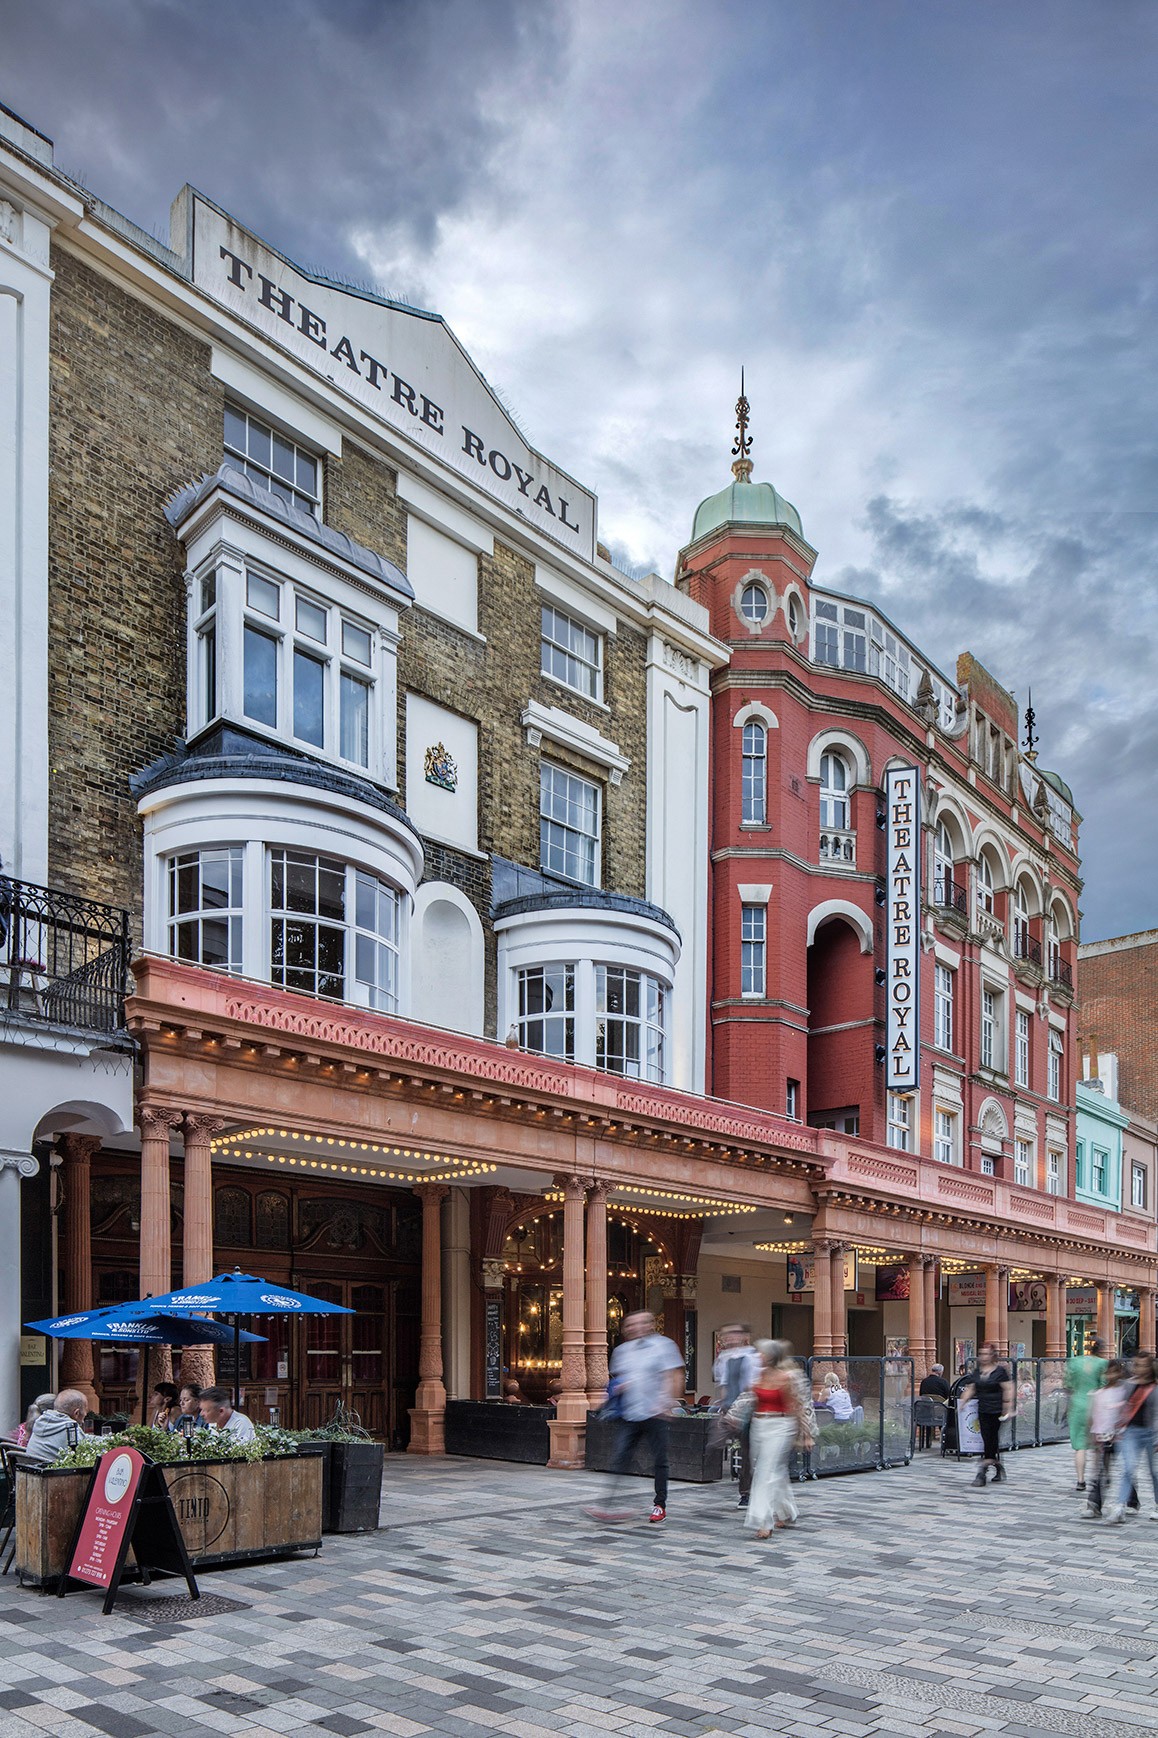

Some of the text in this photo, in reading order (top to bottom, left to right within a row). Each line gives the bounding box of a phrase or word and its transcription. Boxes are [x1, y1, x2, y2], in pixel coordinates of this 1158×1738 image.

[219, 245, 580, 534] THEATRE ROYAL
[892, 778, 912, 1077] THEATRE ROYAL
[106, 1322, 160, 1332] FRANKLIN
[179, 1497, 210, 1519] TINTO
